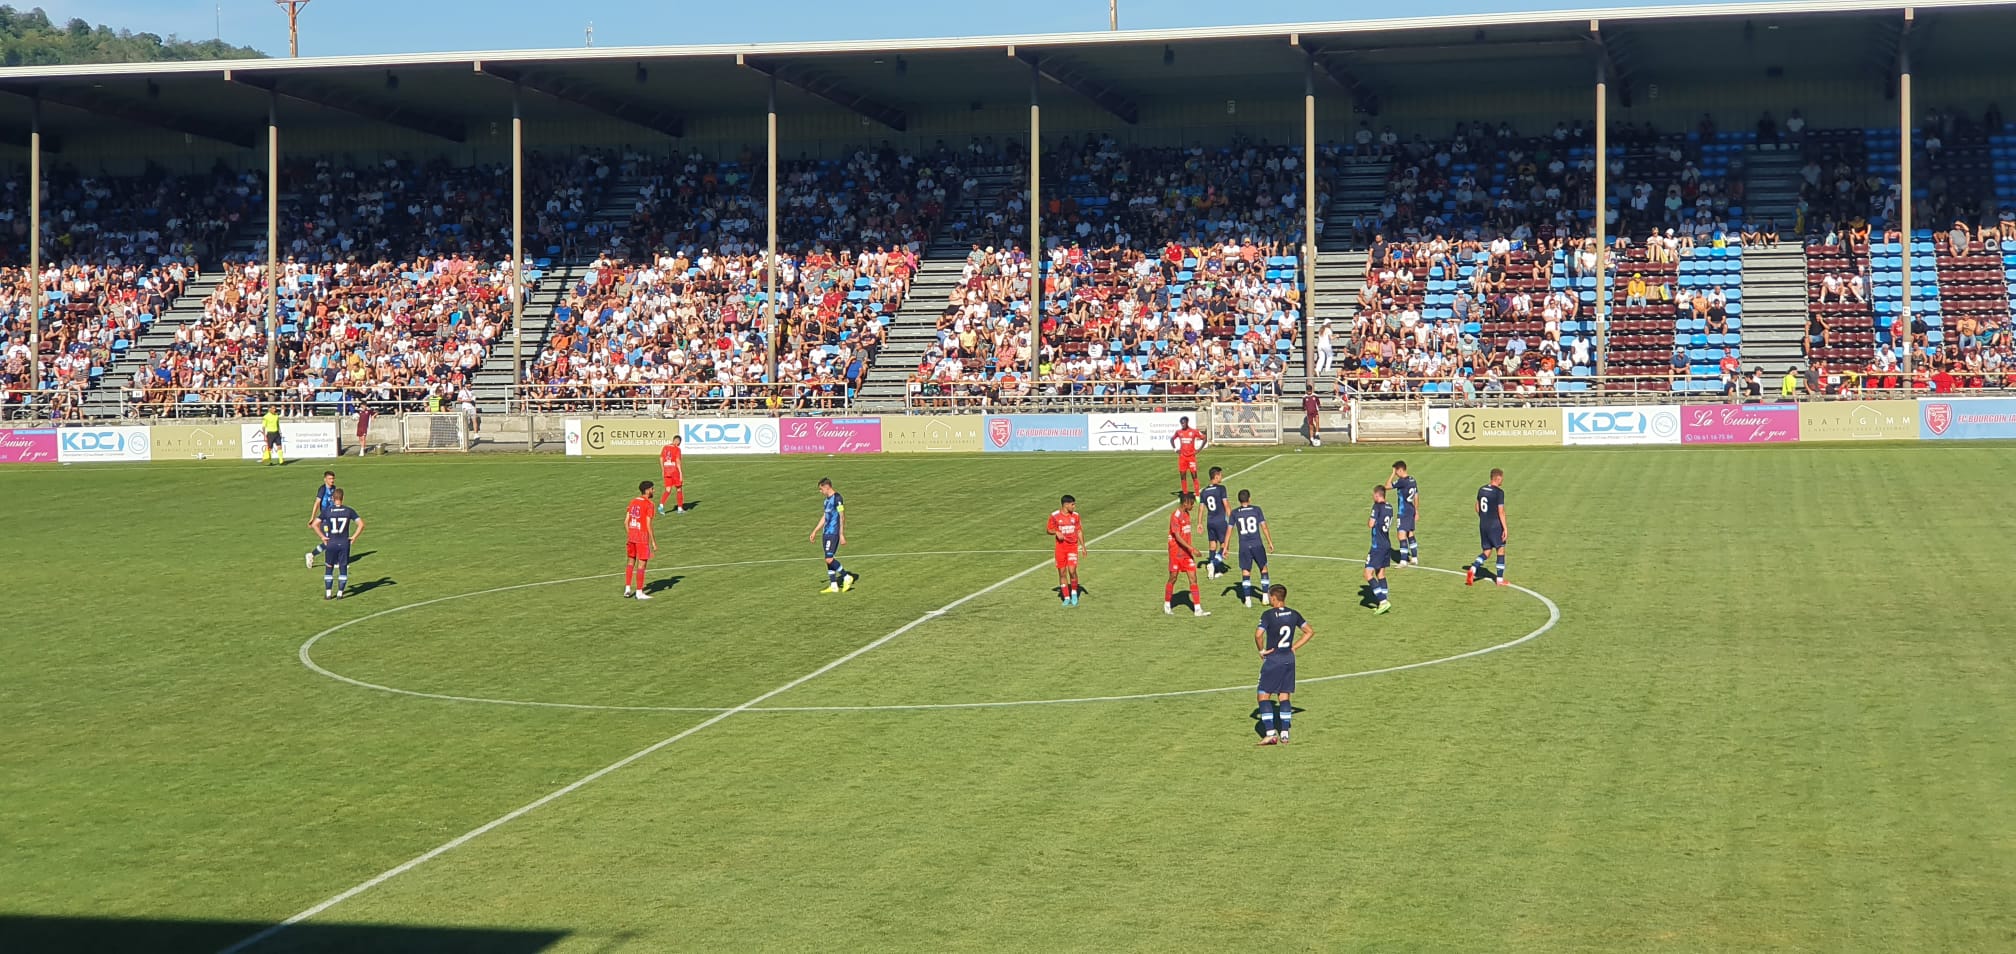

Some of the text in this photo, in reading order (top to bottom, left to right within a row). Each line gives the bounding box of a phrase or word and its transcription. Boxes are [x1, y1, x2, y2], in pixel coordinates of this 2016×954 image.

[1482, 420, 1547, 428] CENTURY 21
[1568, 411, 1634, 432] KDC
[1689, 408, 1772, 427] La Cuisine
[1807, 416, 1911, 426] BATIGIMM
[610, 430, 666, 438] CENTURY 21
[684, 423, 741, 443] KDC
[786, 421, 857, 438] La Cuisine
[888, 431, 976, 439] BATIGIMM
[1748, 425, 1788, 441] for you
[62, 432, 115, 450] KDC
[837, 438, 871, 452] for you
[18, 447, 32, 461] for
[30, 452, 48, 462] you
[1206, 495, 1217, 511] 8
[1480, 496, 1488, 513] 6
[330, 517, 348, 533] 17
[1238, 516, 1257, 534] 18
[1277, 625, 1291, 648] 2
